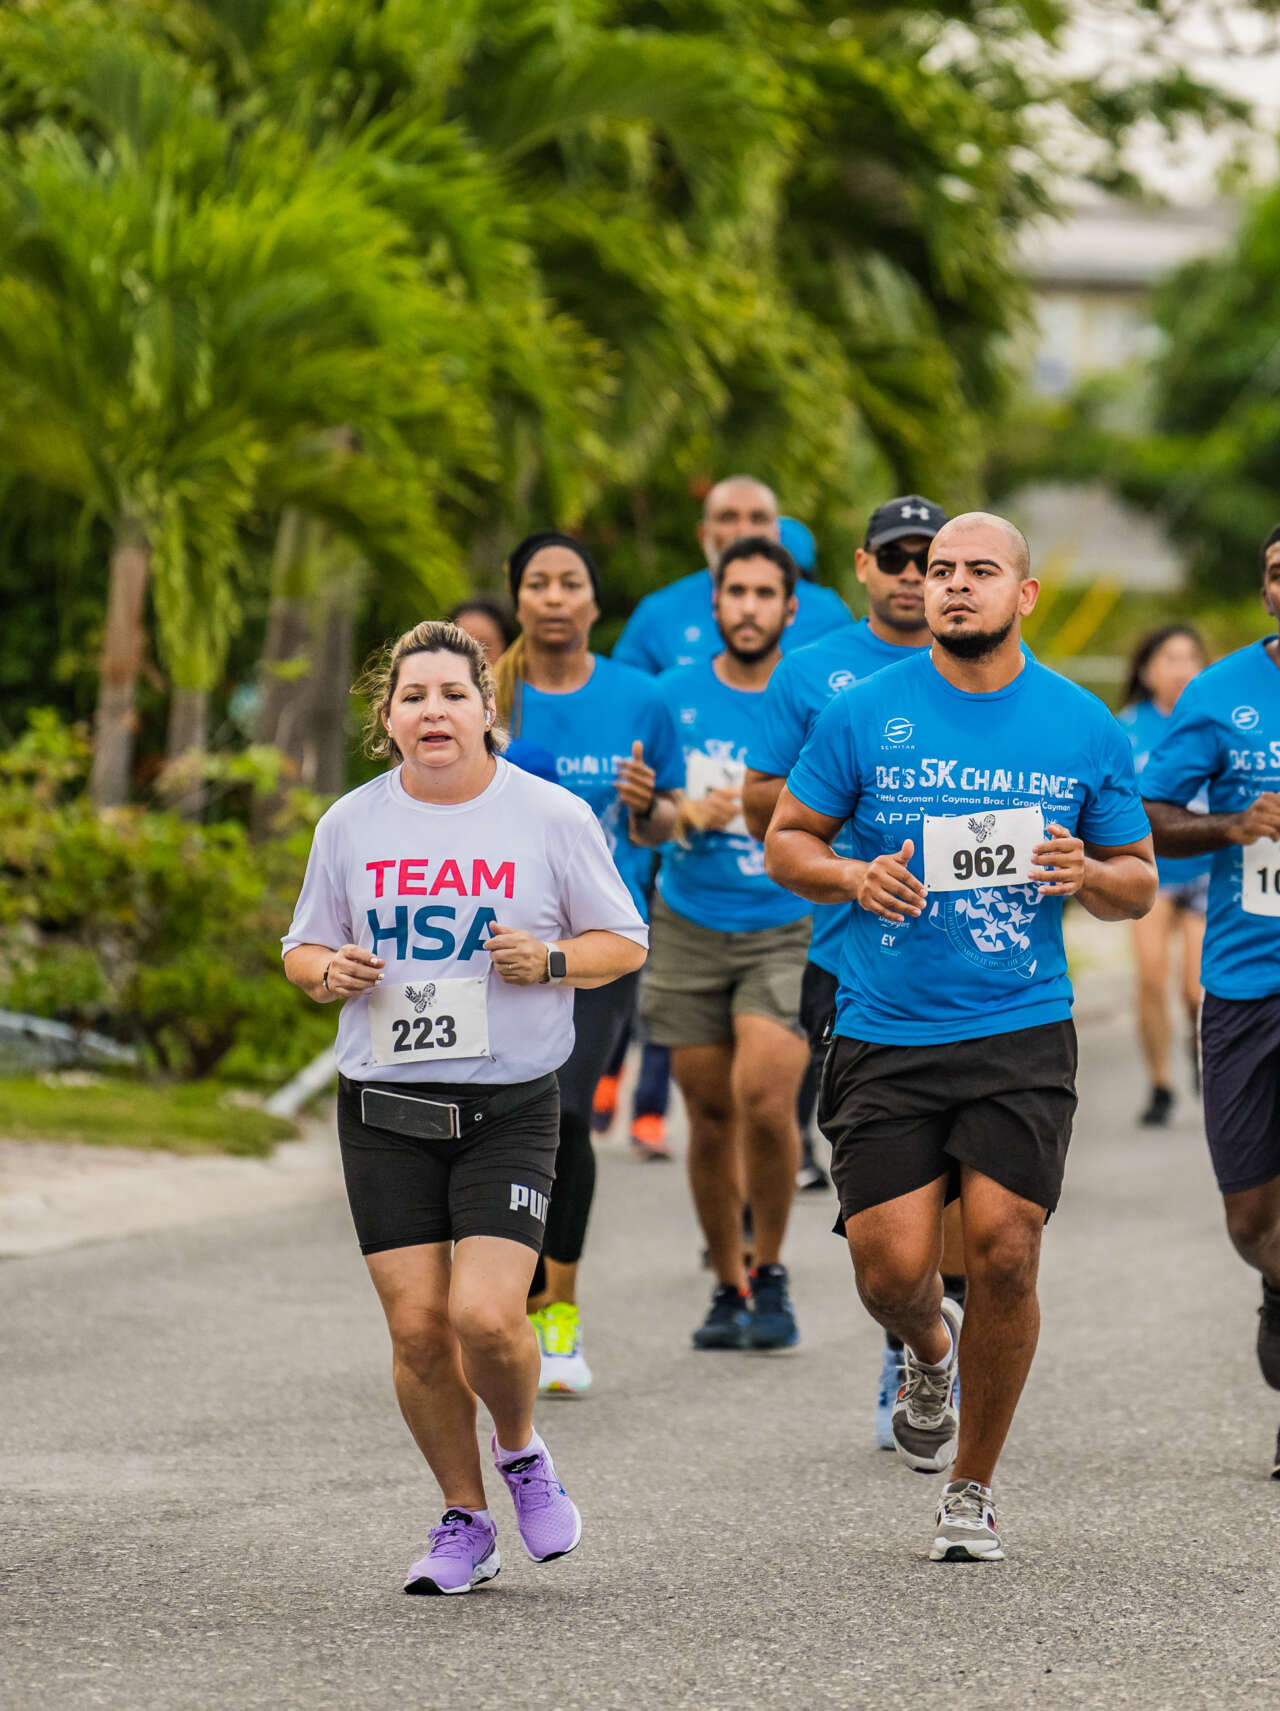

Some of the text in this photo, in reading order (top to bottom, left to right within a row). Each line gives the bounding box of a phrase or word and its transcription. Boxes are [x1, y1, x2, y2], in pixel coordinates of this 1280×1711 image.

[919, 758, 959, 789] 5K
[960, 767, 1079, 799] CHALLENGE
[897, 794, 934, 804] Cayman
[942, 795, 981, 805] Cayman
[983, 796, 1005, 805] Brac
[1012, 797, 1041, 808] Grand
[1042, 801, 1071, 812] Cayman
[366, 858, 516, 899] TEAM
[952, 844, 1016, 881] 962
[367, 905, 501, 961] HSA
[880, 933, 897, 948] EY
[391, 1015, 457, 1053] 223
